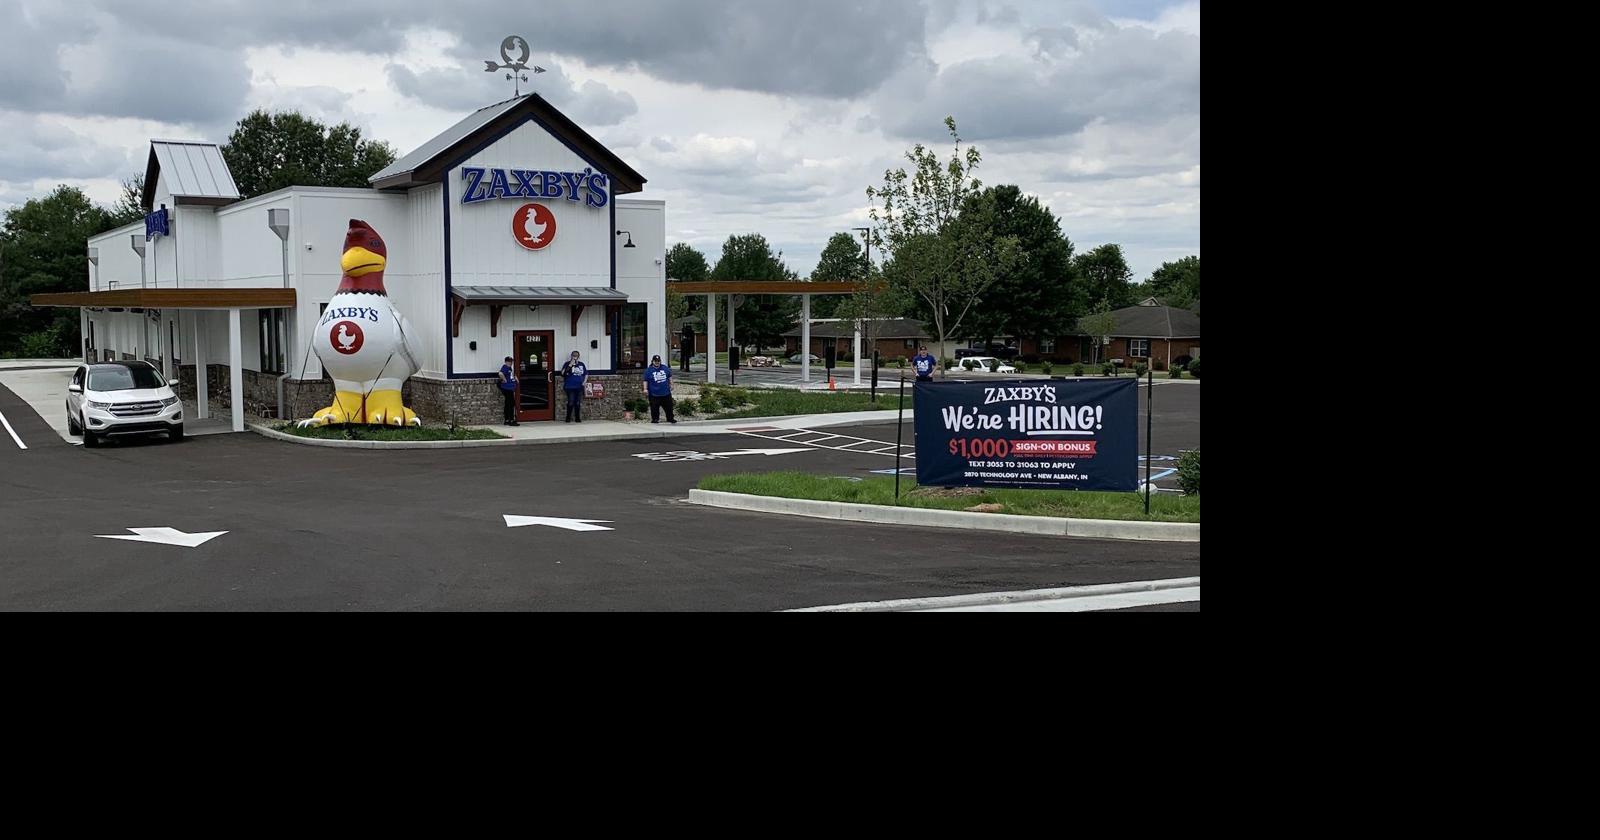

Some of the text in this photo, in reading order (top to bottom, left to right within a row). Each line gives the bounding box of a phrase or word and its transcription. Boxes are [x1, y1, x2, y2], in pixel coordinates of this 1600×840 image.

[462, 167, 608, 208] ZAXBY'S
[984, 385, 1056, 405] ZAXBY'S
[942, 404, 1102, 432] We're HIRING!
[949, 438, 1008, 459] $1,000
[1015, 443, 1091, 451] SIGN-ON BONUS
